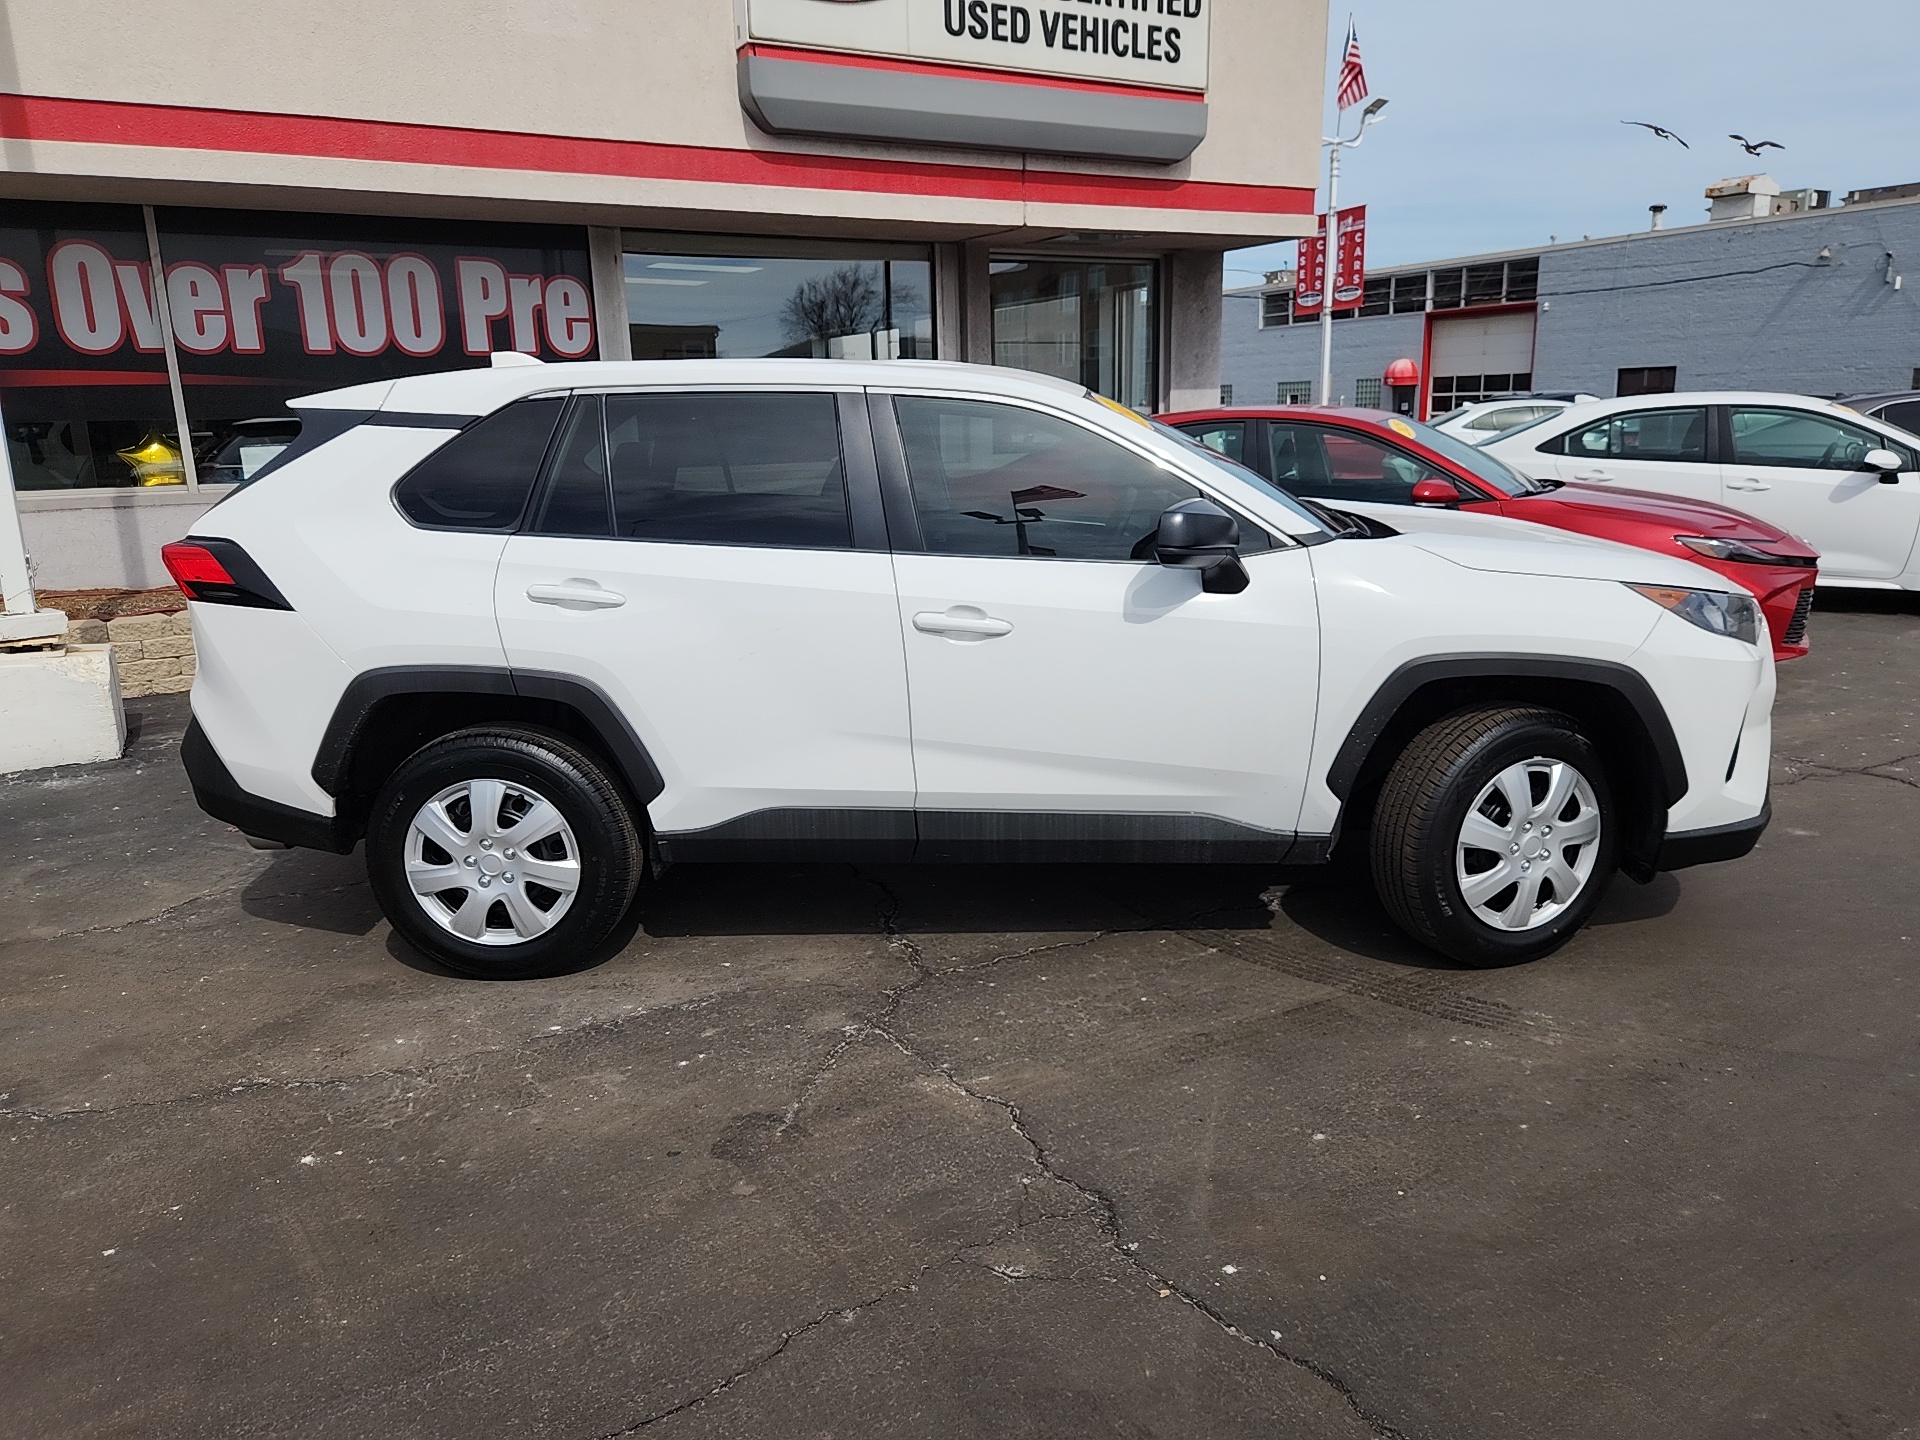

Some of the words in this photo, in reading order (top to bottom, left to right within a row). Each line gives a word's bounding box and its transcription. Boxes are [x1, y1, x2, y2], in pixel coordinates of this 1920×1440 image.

[943, 0, 1031, 44] USED
[1039, 9, 1182, 64] VEHICLES
[1298, 242, 1308, 292] USED
[1315, 240, 1325, 290] CARS
[1336, 236, 1346, 286] USED
[1353, 232, 1363, 284] CARS
[48, 240, 270, 354] Over
[280, 252, 444, 356] 100
[456, 257, 594, 357] Pre
